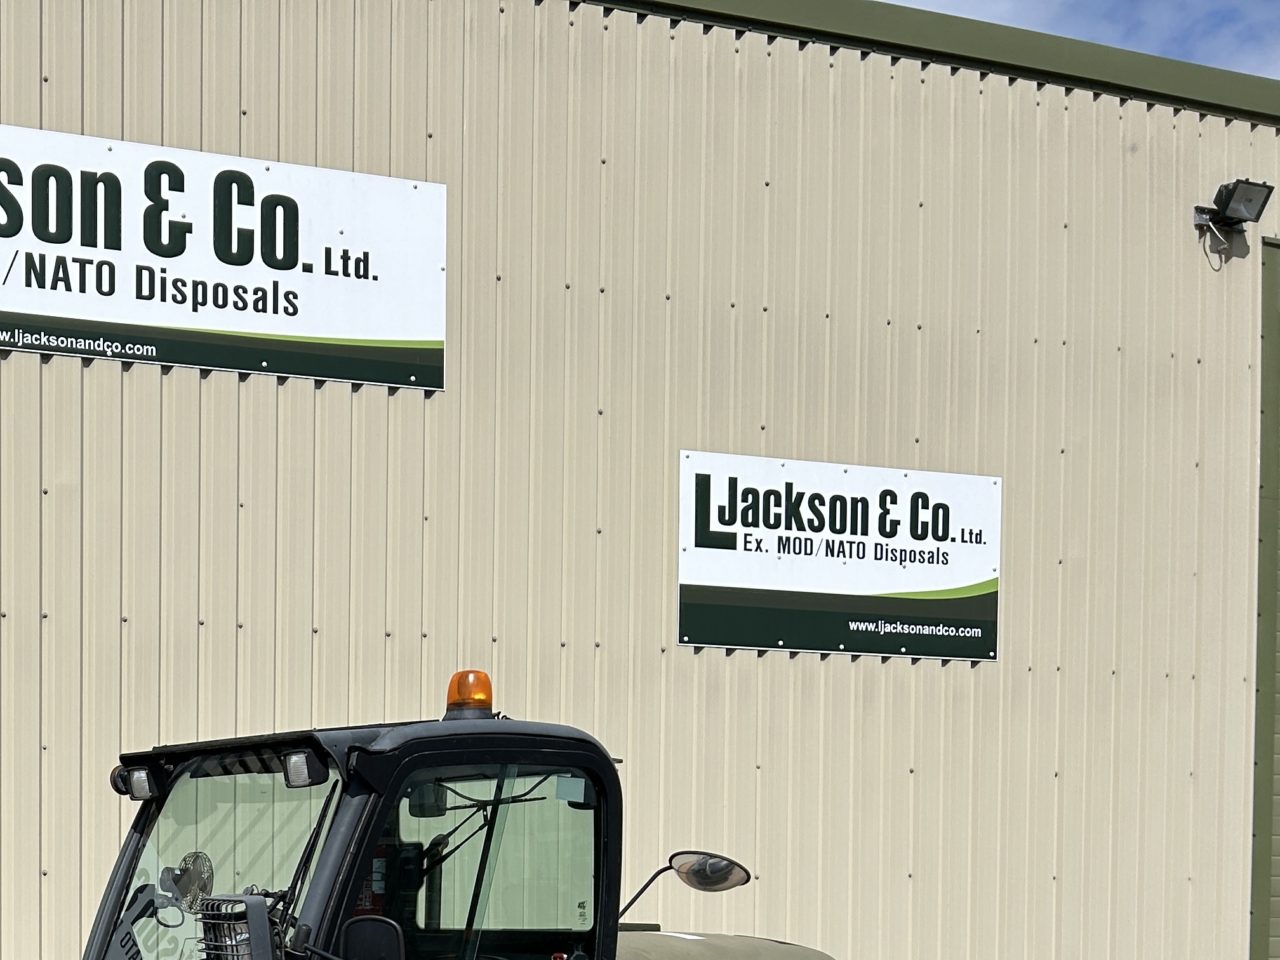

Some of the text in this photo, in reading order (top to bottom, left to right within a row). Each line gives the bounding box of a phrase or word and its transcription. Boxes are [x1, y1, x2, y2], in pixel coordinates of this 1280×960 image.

[143, 161, 192, 258] &
[213, 170, 313, 273] Co.
[325, 247, 378, 281] Ltd.
[136, 265, 298, 316] Disposals
[878, 489, 900, 538] &
[910, 492, 956, 542] Co.
[960, 528, 986, 544] Ltd.
[743, 533, 949, 565] Ex. MOD/NATO Disposals
[848, 619, 982, 637] www.ljacksonandco.com
